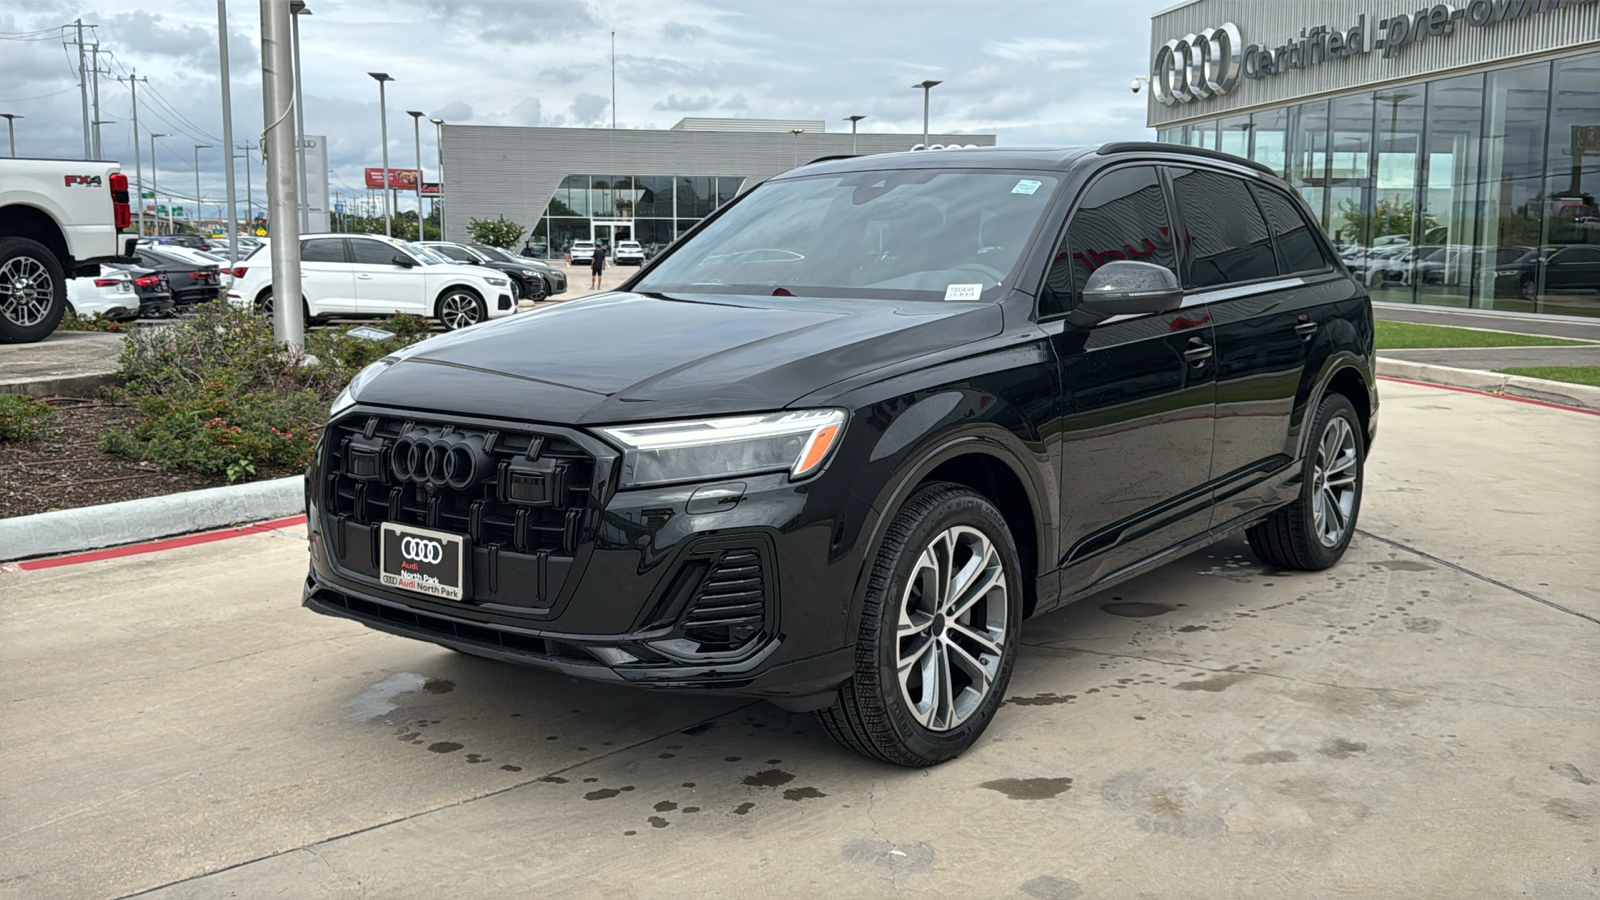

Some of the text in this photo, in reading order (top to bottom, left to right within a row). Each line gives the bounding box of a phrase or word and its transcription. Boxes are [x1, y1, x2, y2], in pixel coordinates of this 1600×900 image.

[1242, 13, 1367, 79] Certified
[64, 174, 102, 187] FX4
[401, 560, 418, 571] Audi
[401, 570, 440, 584] North Park
[398, 578, 458, 598] Audi North Park
